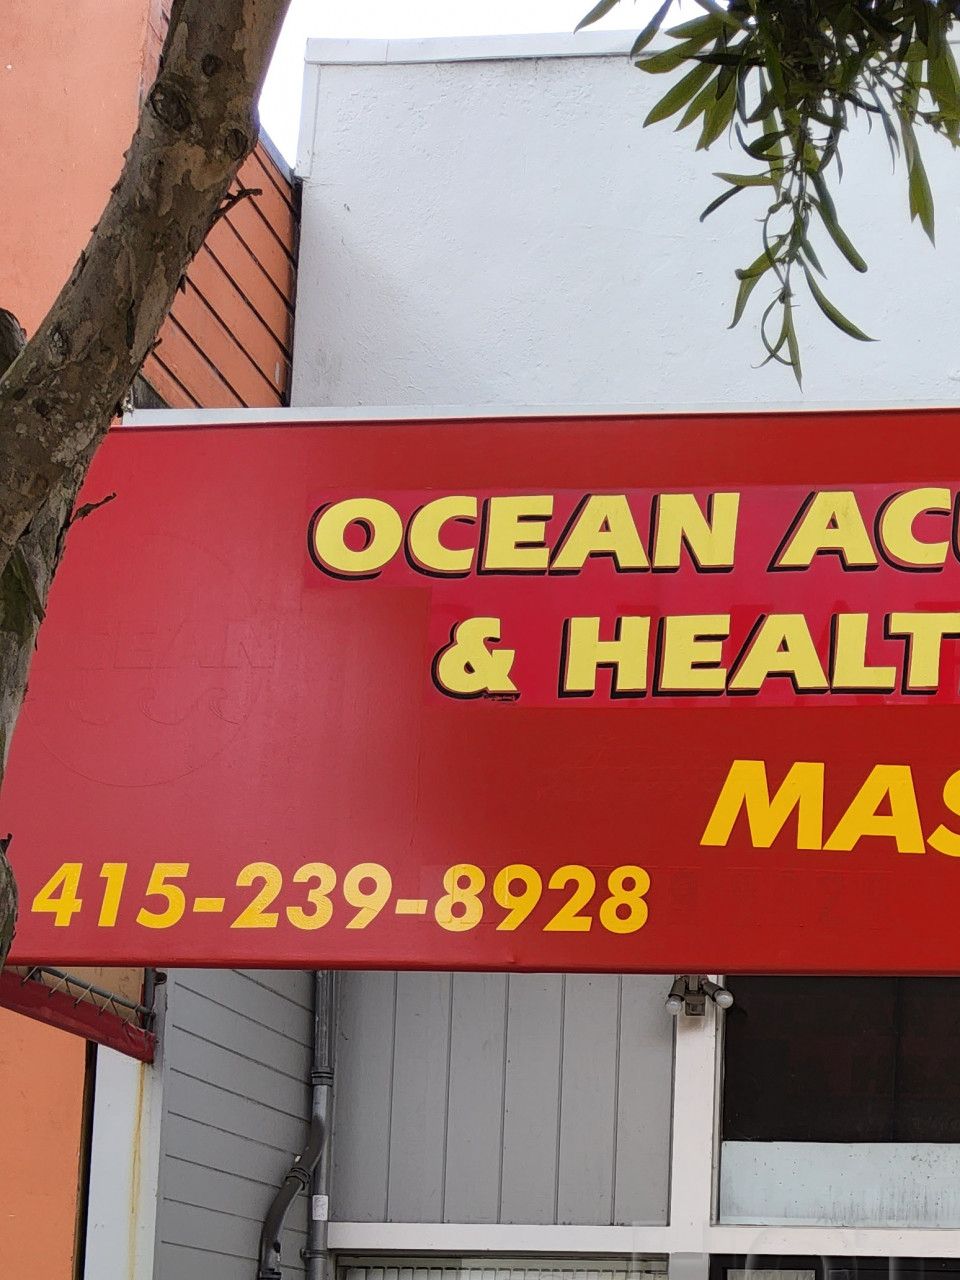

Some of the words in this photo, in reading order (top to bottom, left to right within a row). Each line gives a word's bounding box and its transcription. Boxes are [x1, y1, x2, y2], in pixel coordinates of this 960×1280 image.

[311, 492, 741, 578] OCEAN
[433, 617, 519, 700] &
[31, 862, 650, 934] 415-239-8928
